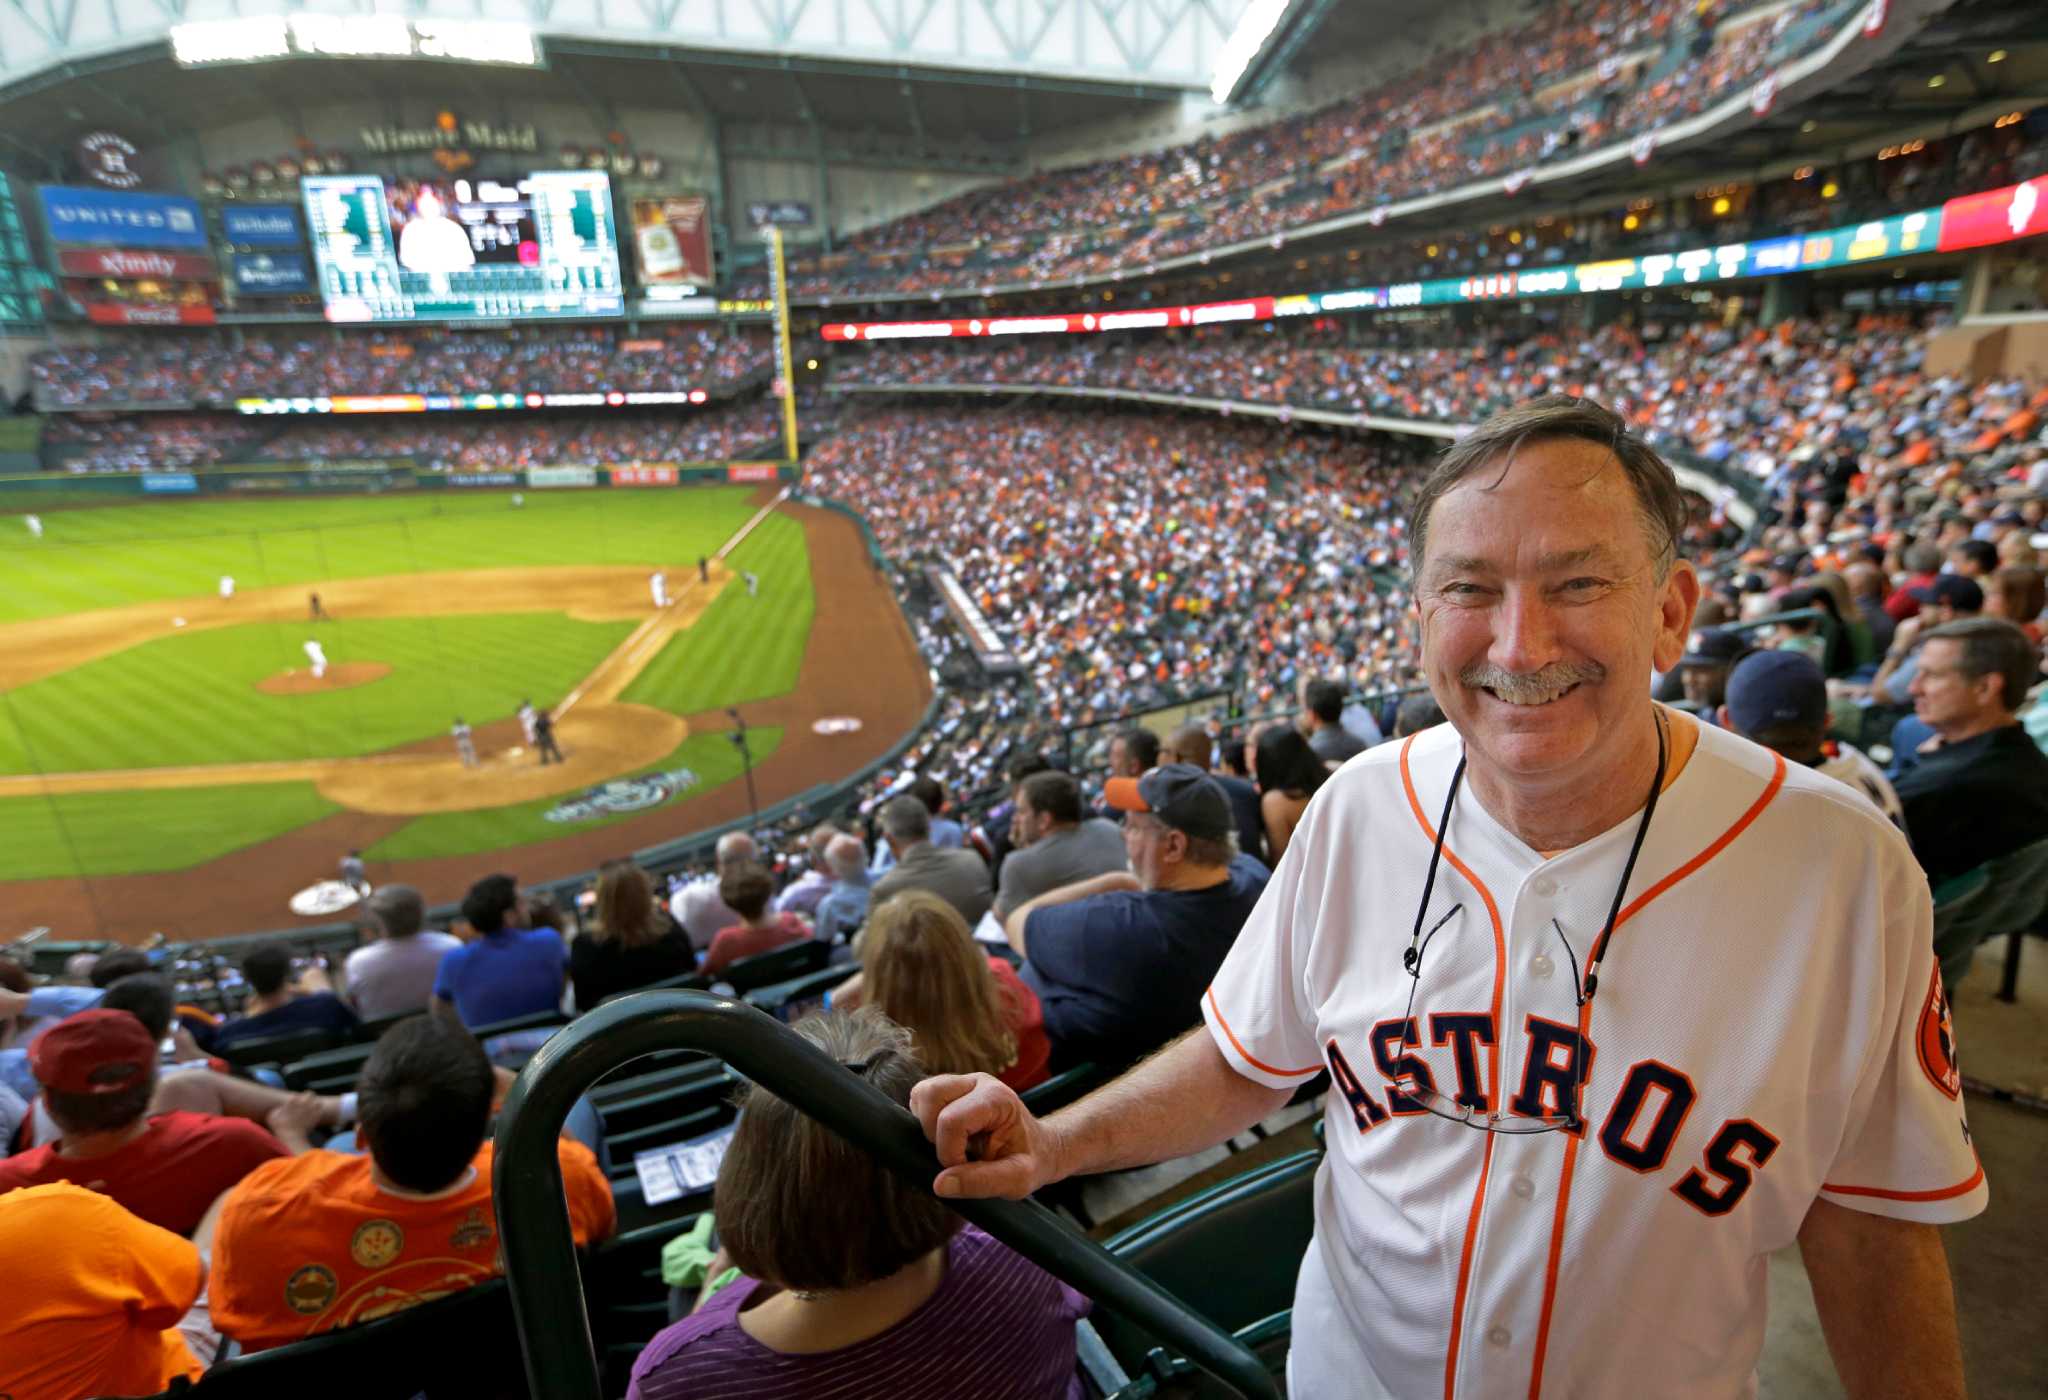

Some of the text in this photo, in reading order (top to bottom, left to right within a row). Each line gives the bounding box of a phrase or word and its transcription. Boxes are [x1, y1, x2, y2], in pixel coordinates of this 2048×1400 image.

[361, 121, 537, 151] Minute Maid
[54, 205, 164, 228] UNITED
[1325, 1011, 1781, 1218] ASTROS
